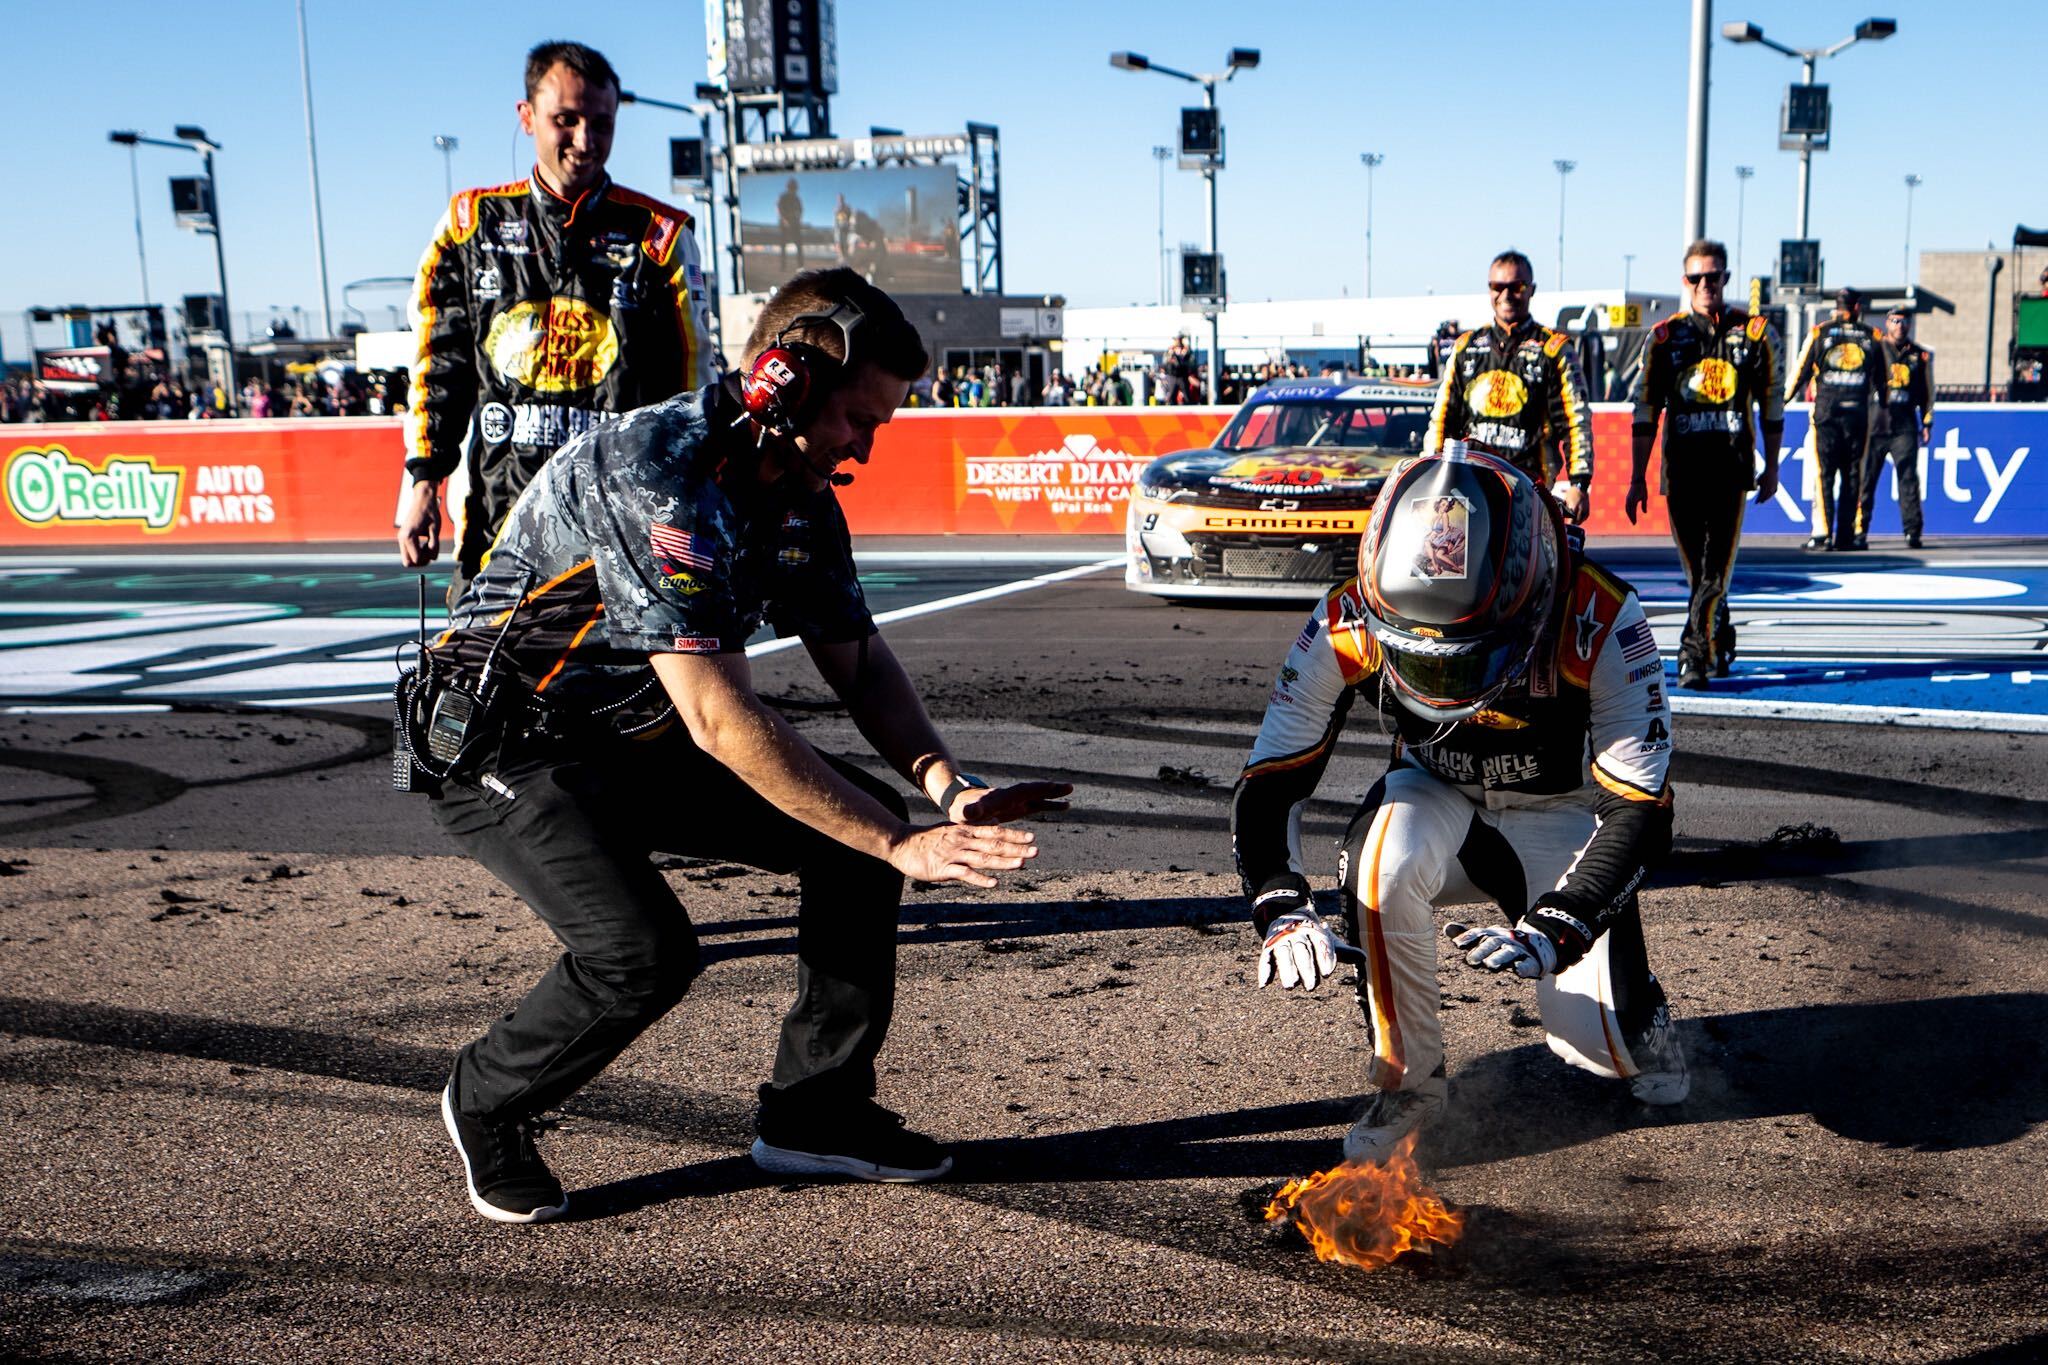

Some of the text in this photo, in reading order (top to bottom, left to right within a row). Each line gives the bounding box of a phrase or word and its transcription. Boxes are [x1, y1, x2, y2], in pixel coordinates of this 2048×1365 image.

[1361, 388, 1438, 398] GRAGSO
[196, 465, 265, 494] AUTO
[966, 463, 1064, 485] DESERT
[14, 457, 171, 520] O'Reilly
[995, 487, 1042, 501] WEST
[1045, 486, 1106, 501] VALLEY
[1230, 482, 1333, 495] ANNIVERSARY
[189, 495, 275, 523] PARTS
[1143, 513, 1159, 531] 9
[1205, 517, 1354, 529] CAMARO
[1420, 629, 1436, 638] Bass
[677, 639, 718, 649] SIMPSON
[1481, 753, 1539, 778] RIFLE
